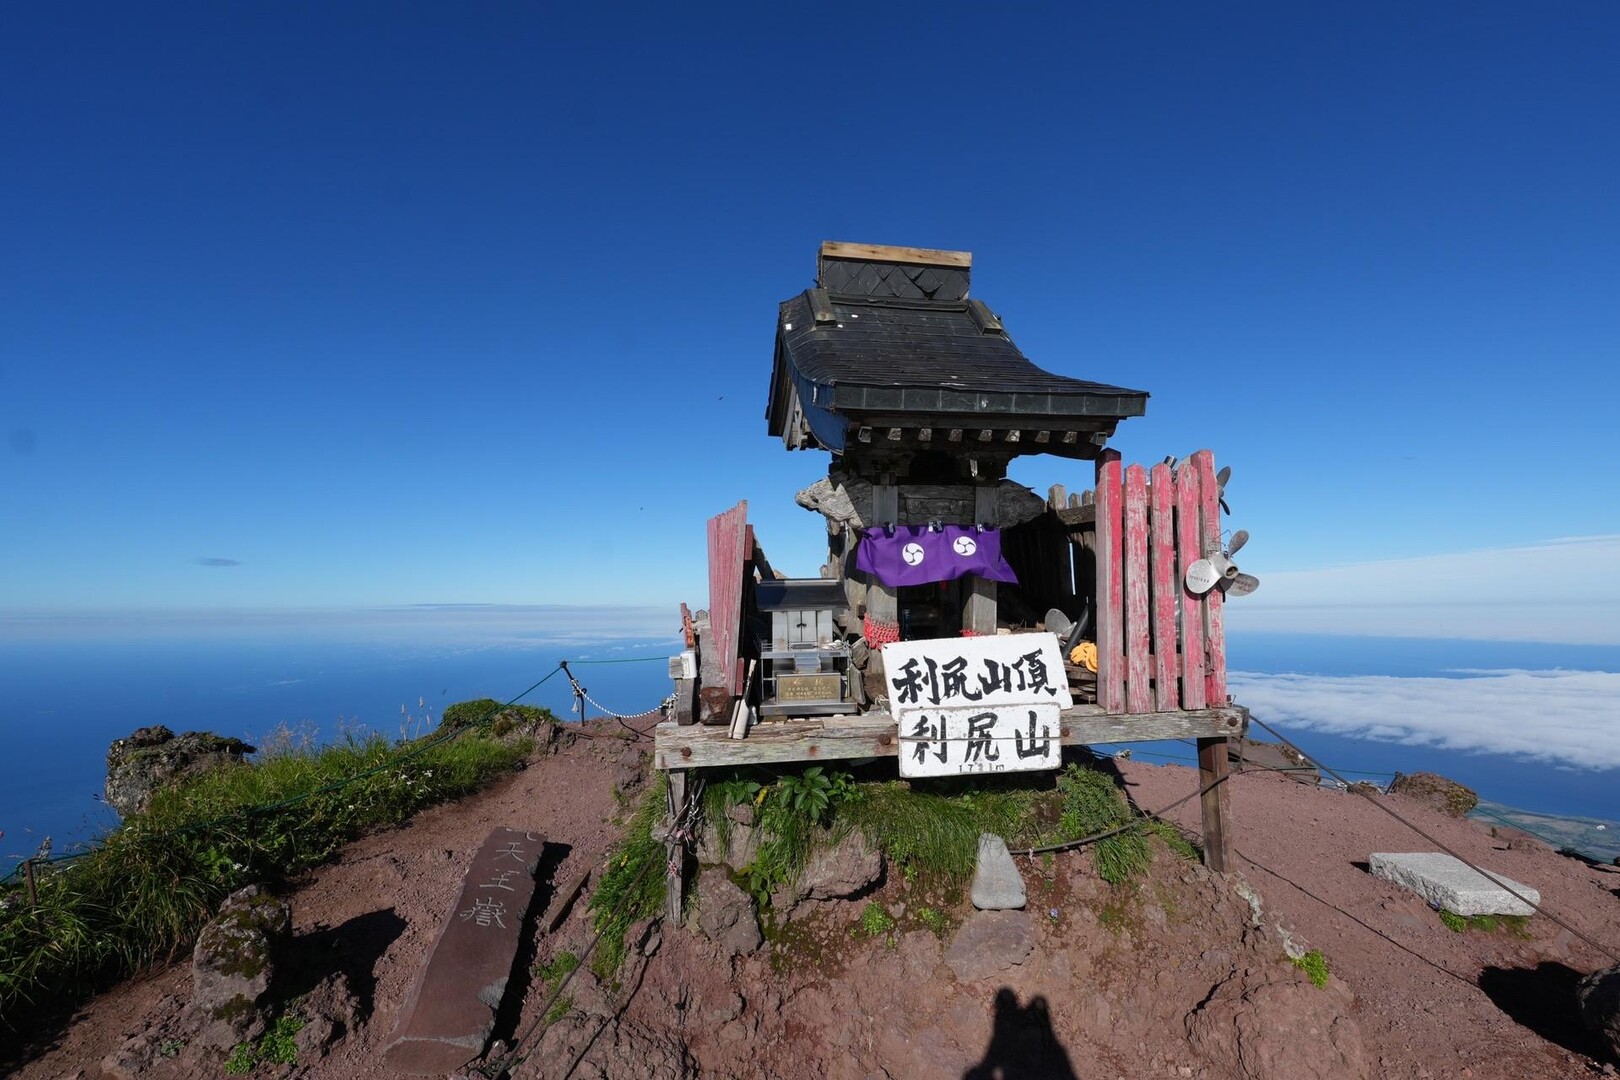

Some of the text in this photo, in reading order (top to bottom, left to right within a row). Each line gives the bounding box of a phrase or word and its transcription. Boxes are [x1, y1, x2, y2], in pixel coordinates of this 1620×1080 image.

[892, 648, 1057, 705] 利尻山頂
[911, 711, 1050, 765] 利尻山
